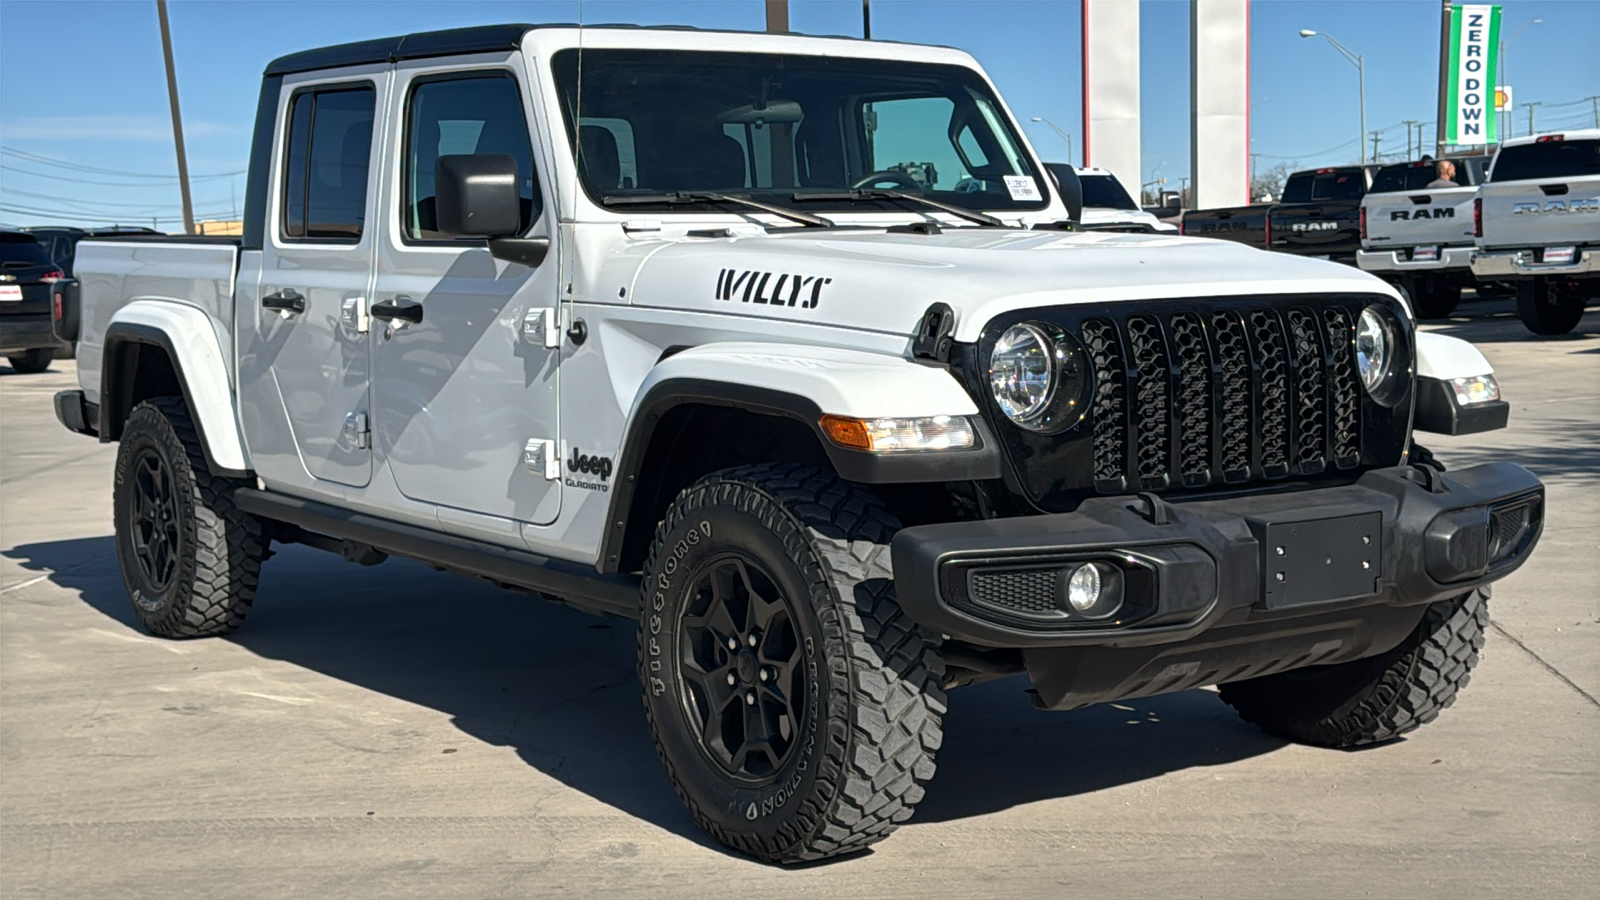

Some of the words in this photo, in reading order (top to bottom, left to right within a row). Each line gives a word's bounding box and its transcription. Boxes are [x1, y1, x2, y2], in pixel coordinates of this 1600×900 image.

[1465, 14, 1483, 73] ZERO
[1462, 78, 1482, 135] DOWN
[1390, 207, 1455, 221] RAM
[1513, 199, 1599, 214] RAM
[1292, 222, 1338, 232] RAM
[715, 268, 833, 309] WILLYS
[567, 447, 612, 481] Jeep
[565, 478, 609, 492] GLADIATO
[761, 636, 819, 817] DESTINATION
